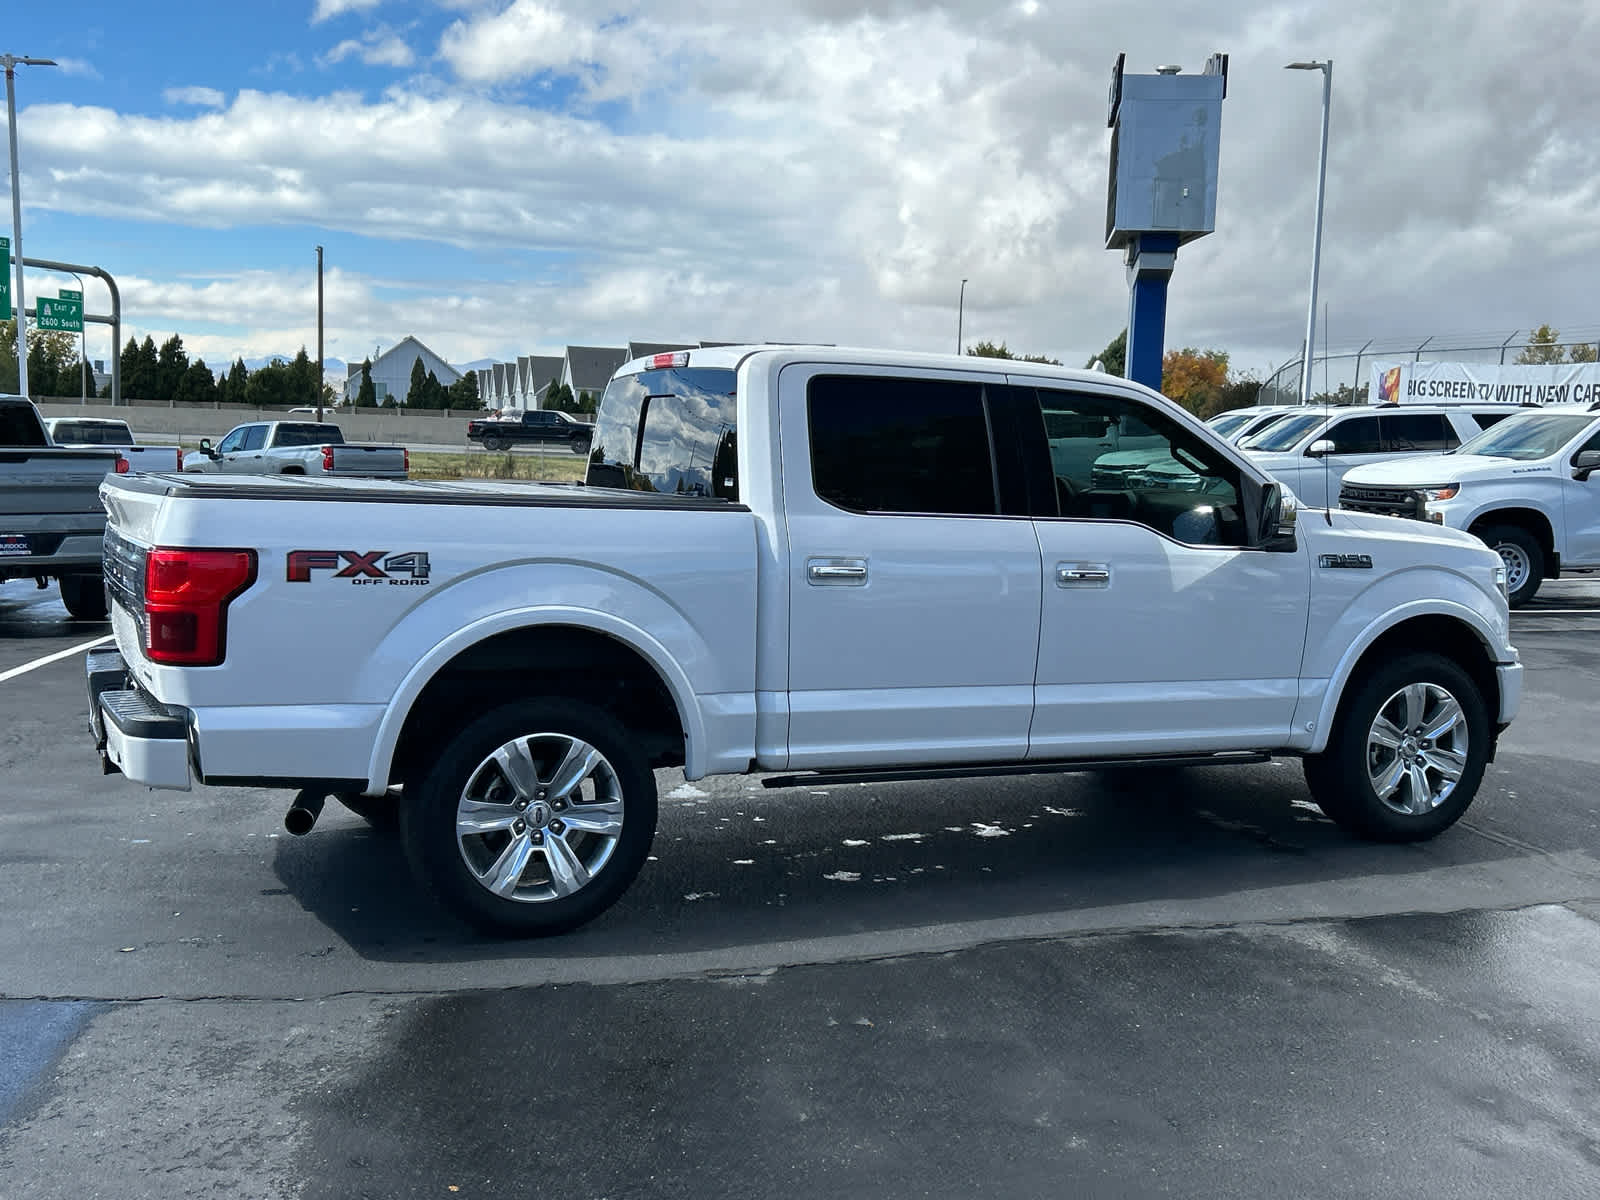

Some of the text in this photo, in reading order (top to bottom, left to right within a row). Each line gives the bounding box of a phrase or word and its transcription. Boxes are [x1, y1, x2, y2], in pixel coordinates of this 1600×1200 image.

[41, 317, 80, 329] 2600 South
[1407, 380, 1427, 397] BIG
[1428, 380, 1476, 400] SCREEN
[1477, 383, 1496, 401] TV
[1496, 385, 1531, 402] WITH
[1536, 384, 1570, 403] NEW
[286, 550, 431, 582] FX4
